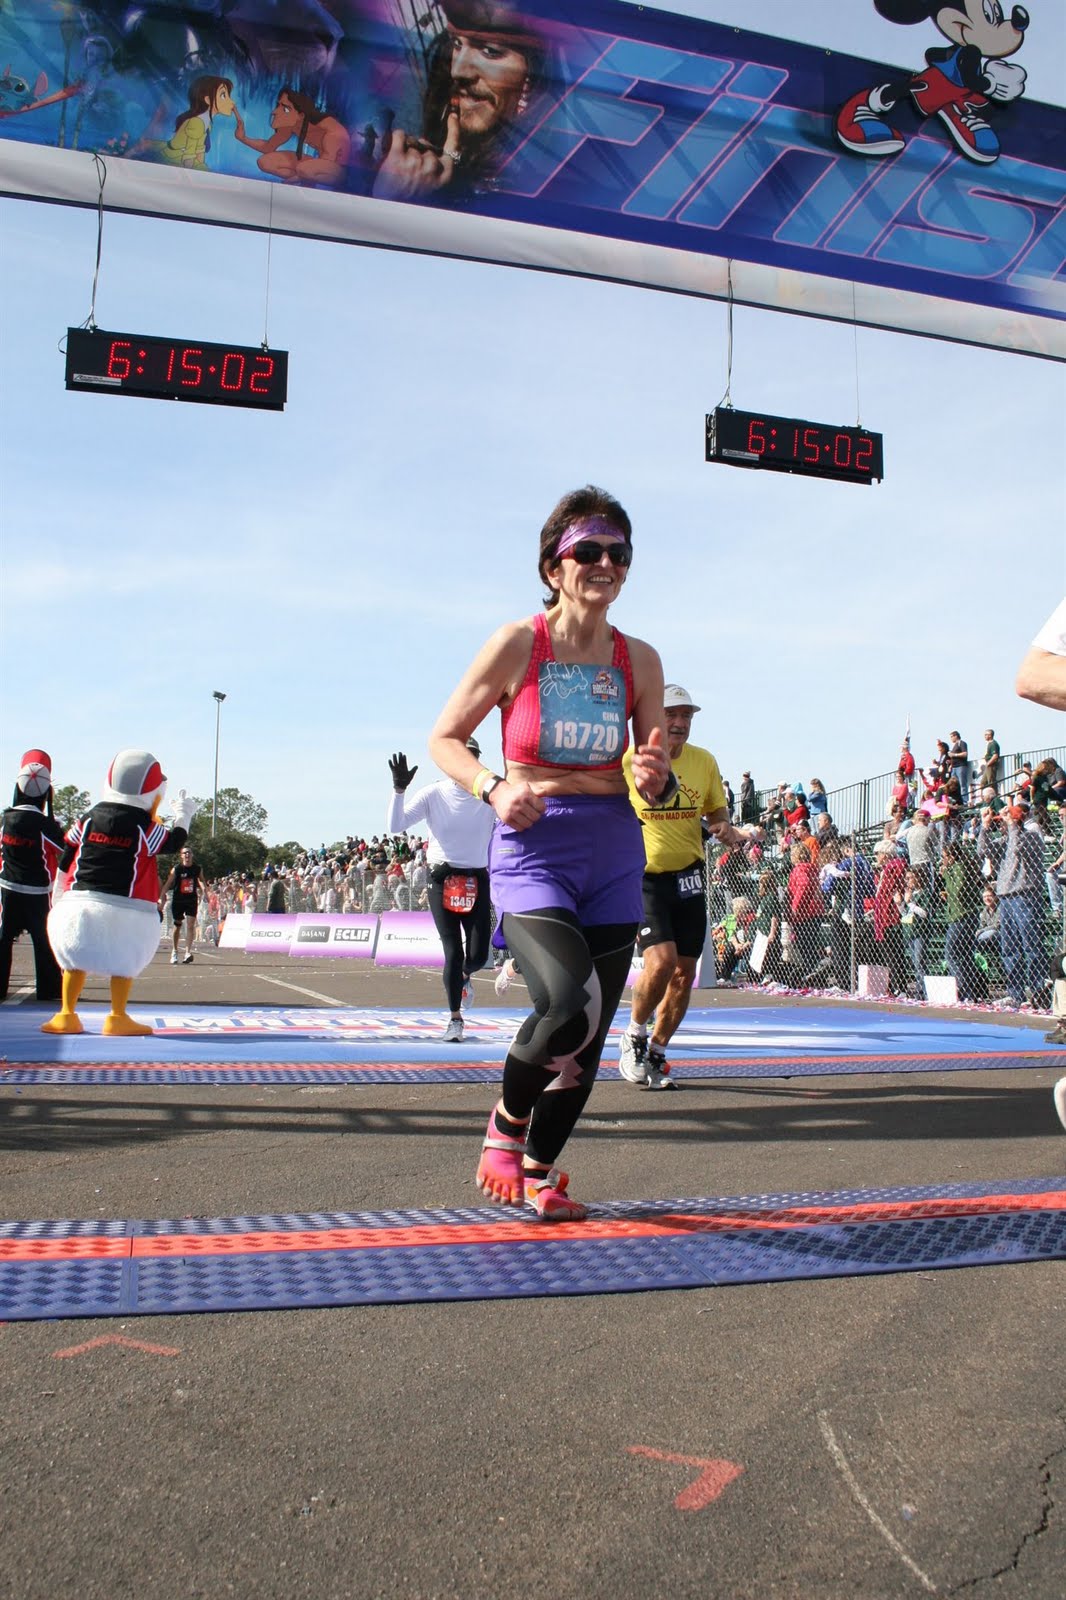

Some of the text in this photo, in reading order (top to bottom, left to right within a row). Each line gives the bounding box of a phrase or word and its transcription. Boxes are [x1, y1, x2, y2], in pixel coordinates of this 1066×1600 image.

[554, 720, 619, 753] 13720
[650, 812, 665, 821] Pete
[665, 811, 680, 820] MAD
[87, 831, 132, 848] DONALD
[250, 930, 283, 939] GEICO
[300, 930, 326, 938] DASANI
[384, 933, 429, 943] Champion
